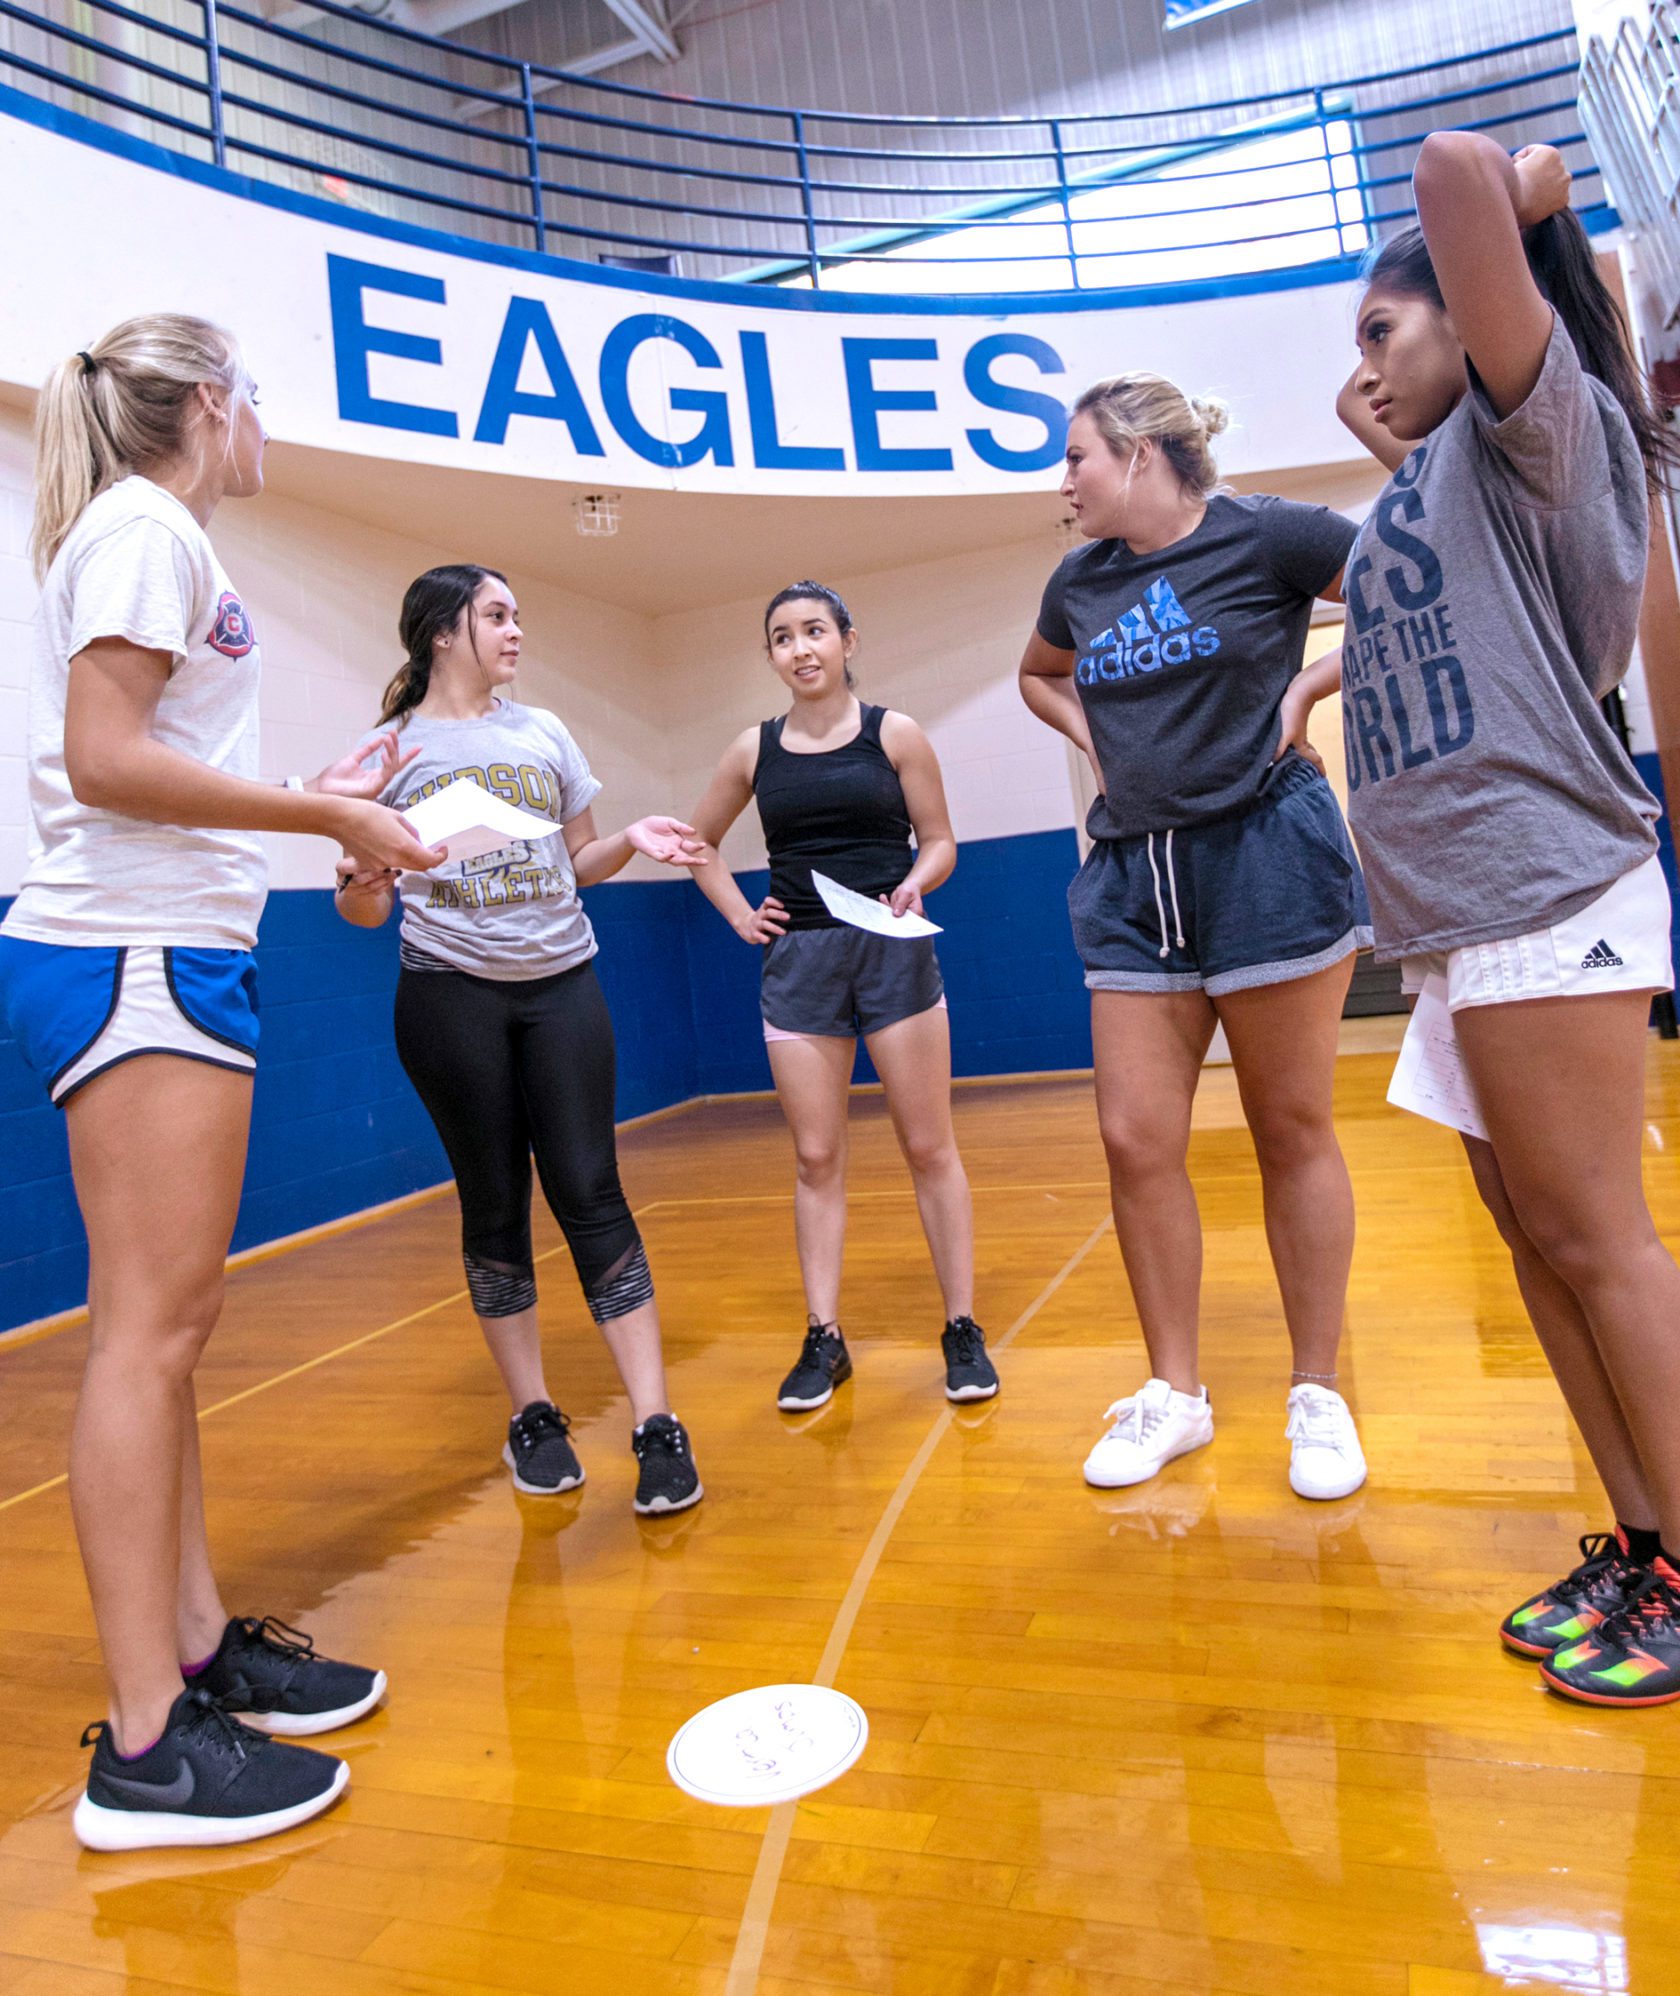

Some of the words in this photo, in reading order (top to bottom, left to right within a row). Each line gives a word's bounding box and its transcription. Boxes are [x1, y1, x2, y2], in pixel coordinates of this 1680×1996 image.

[326, 252, 1068, 472] EAGLES
[1077, 626, 1221, 686] adidas
[1392, 604, 1457, 663] THE
[1581, 957, 1623, 969] adidas
